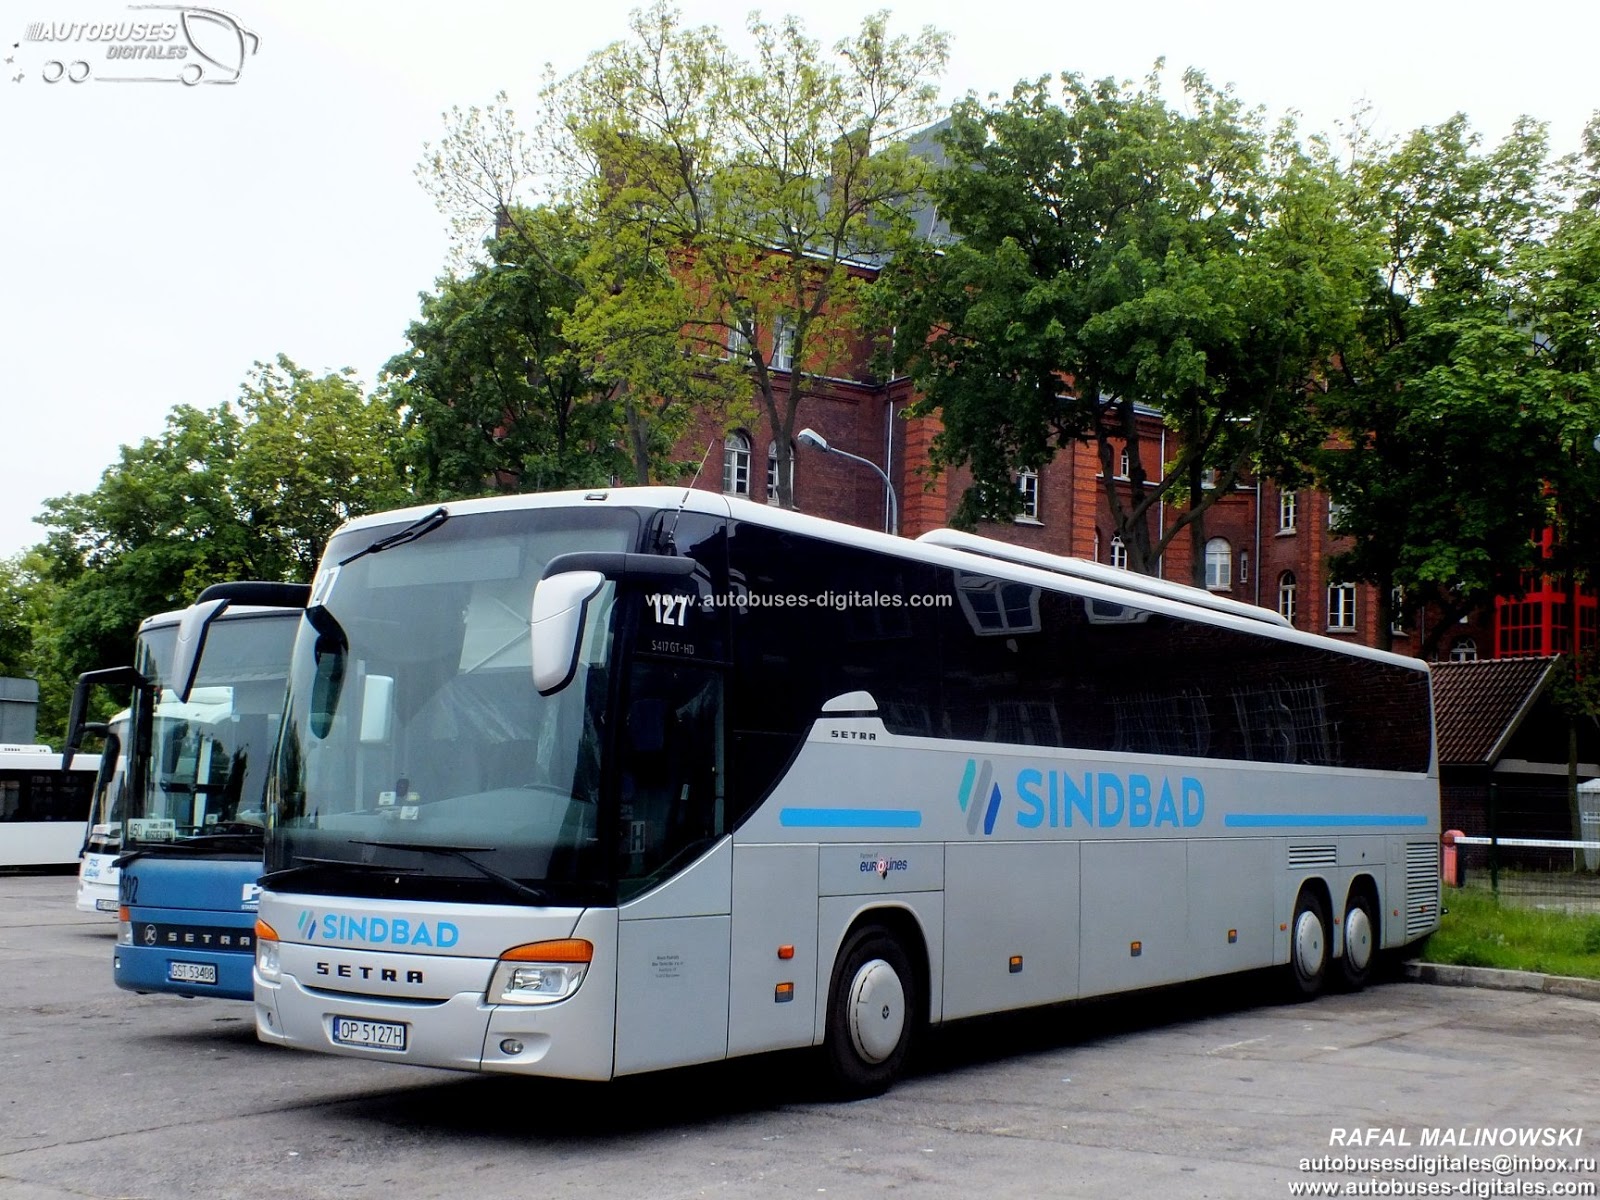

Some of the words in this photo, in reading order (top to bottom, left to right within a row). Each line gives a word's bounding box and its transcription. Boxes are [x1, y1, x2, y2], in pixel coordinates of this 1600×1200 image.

[655, 592, 687, 627] 127
[831, 730, 877, 741] SETRA
[1016, 768, 1205, 829] SINDBAD
[167, 932, 251, 946] SETRA
[322, 914, 460, 948] SINDBAD
[172, 964, 187, 977] GST
[316, 962, 424, 984] SETRA
[341, 1022, 359, 1039] OP
[362, 1024, 402, 1045] 5127H
